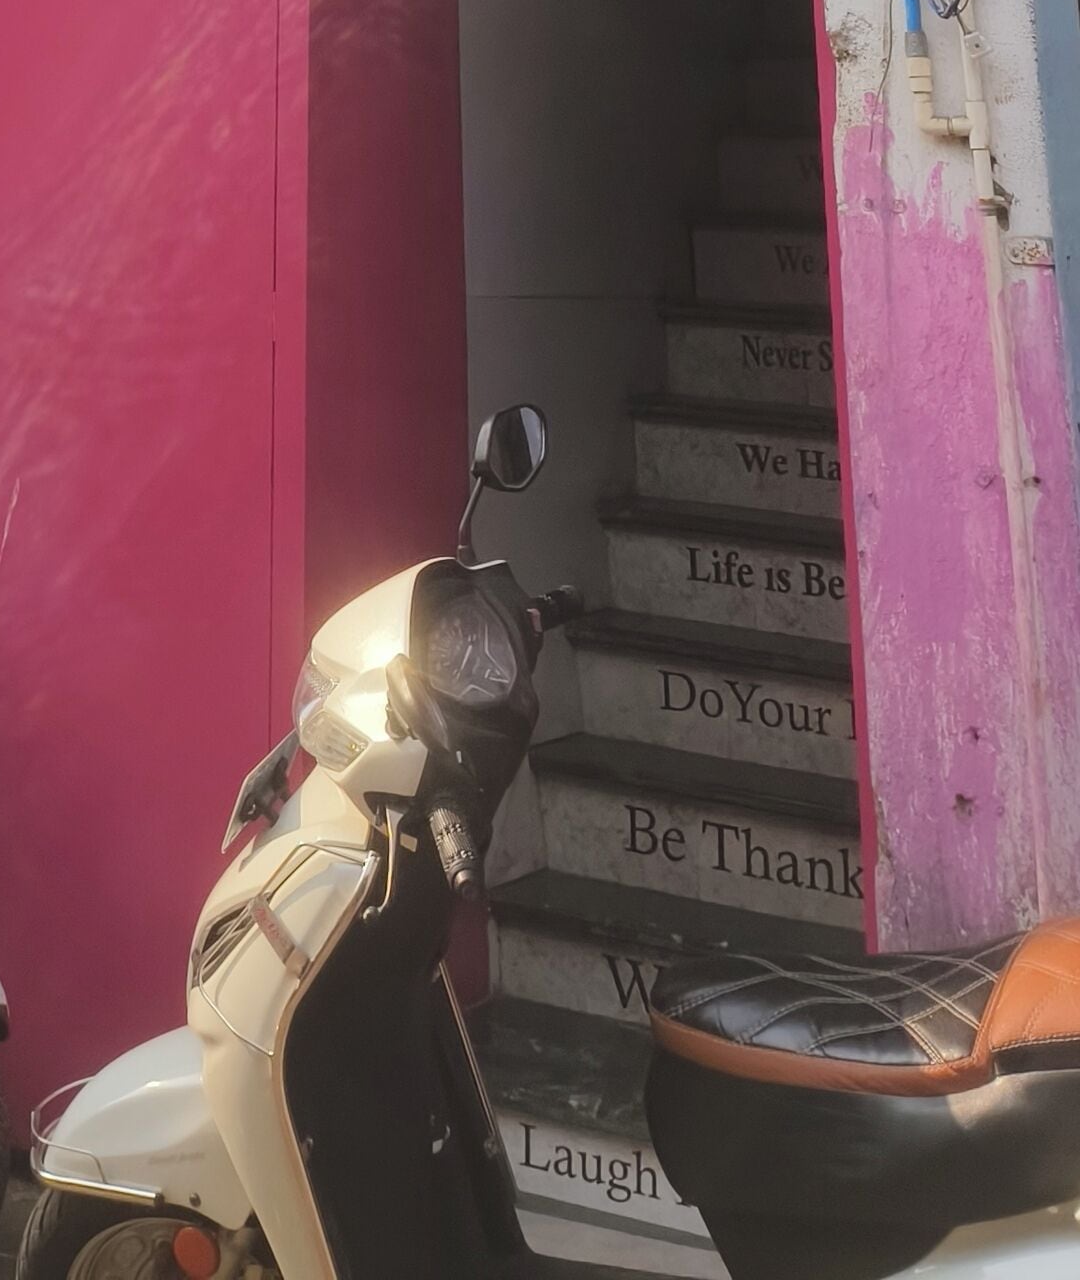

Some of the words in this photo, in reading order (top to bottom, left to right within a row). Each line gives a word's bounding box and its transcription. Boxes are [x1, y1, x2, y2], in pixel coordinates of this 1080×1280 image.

[741, 333, 812, 371] Never
[736, 442, 788, 476] We
[686, 546, 755, 588] Life
[623, 804, 686, 862] Be
[519, 1122, 661, 1203] Laugh
